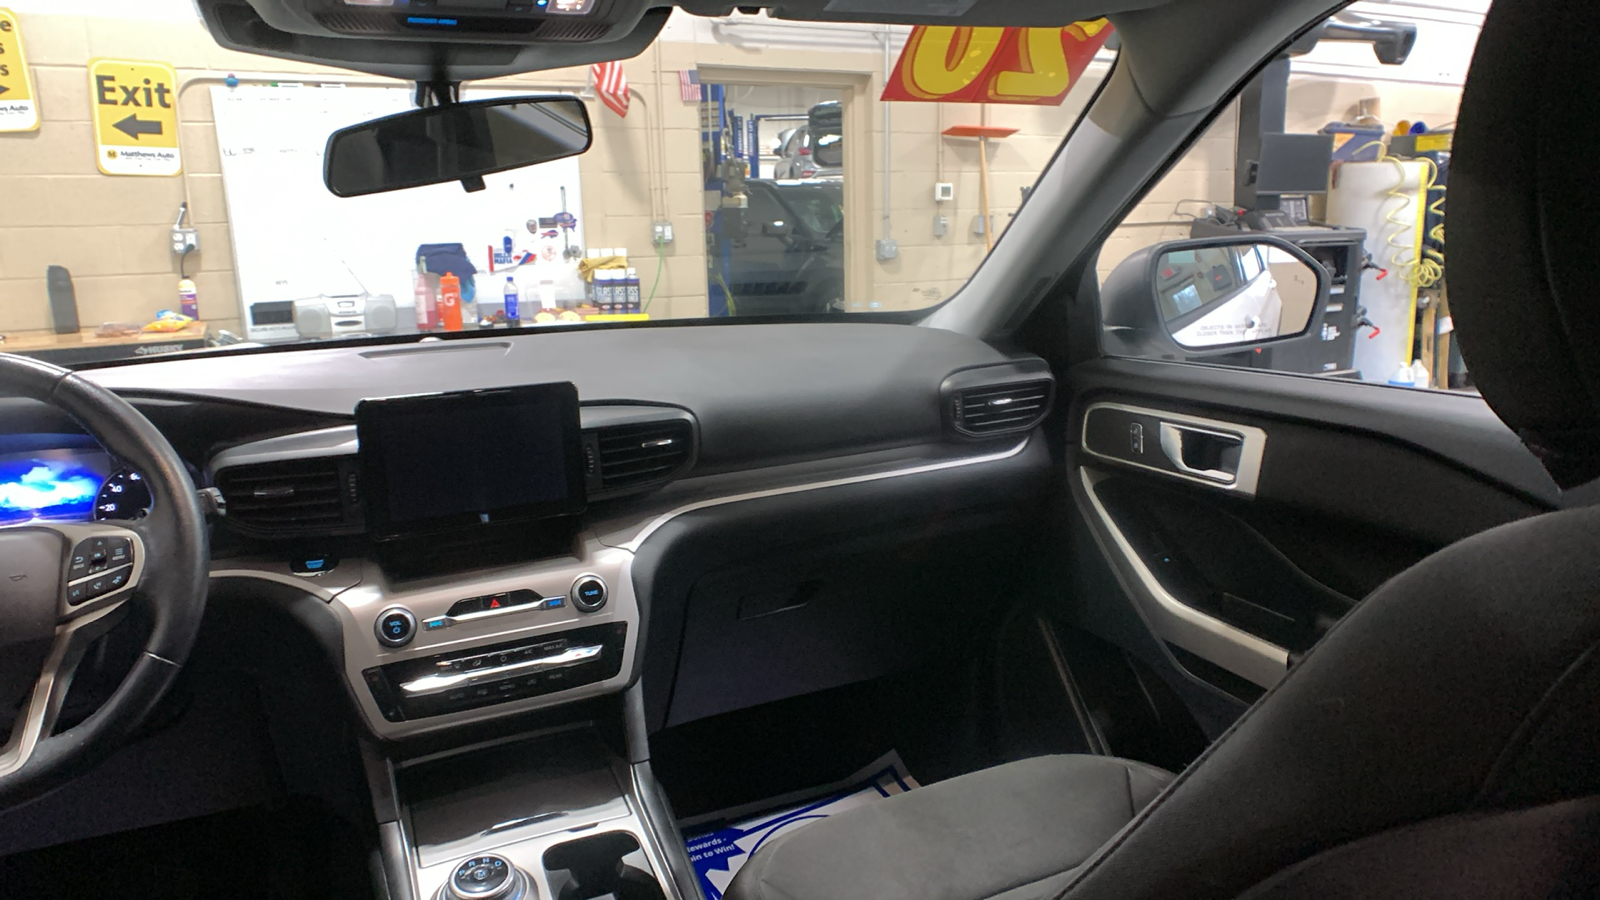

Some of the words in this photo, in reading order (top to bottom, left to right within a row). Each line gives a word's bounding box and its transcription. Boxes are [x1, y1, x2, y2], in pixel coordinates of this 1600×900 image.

[95, 74, 172, 109] Exit
[443, 292, 455, 307] G
[147, 344, 184, 354] HUSKY
[111, 484, 123, 493] 40
[105, 503, 116, 512] 20
[585, 589, 599, 597] TUNE
[702, 850, 714, 858] to
[713, 844, 735, 855] Win!
[477, 869, 487, 877] M
